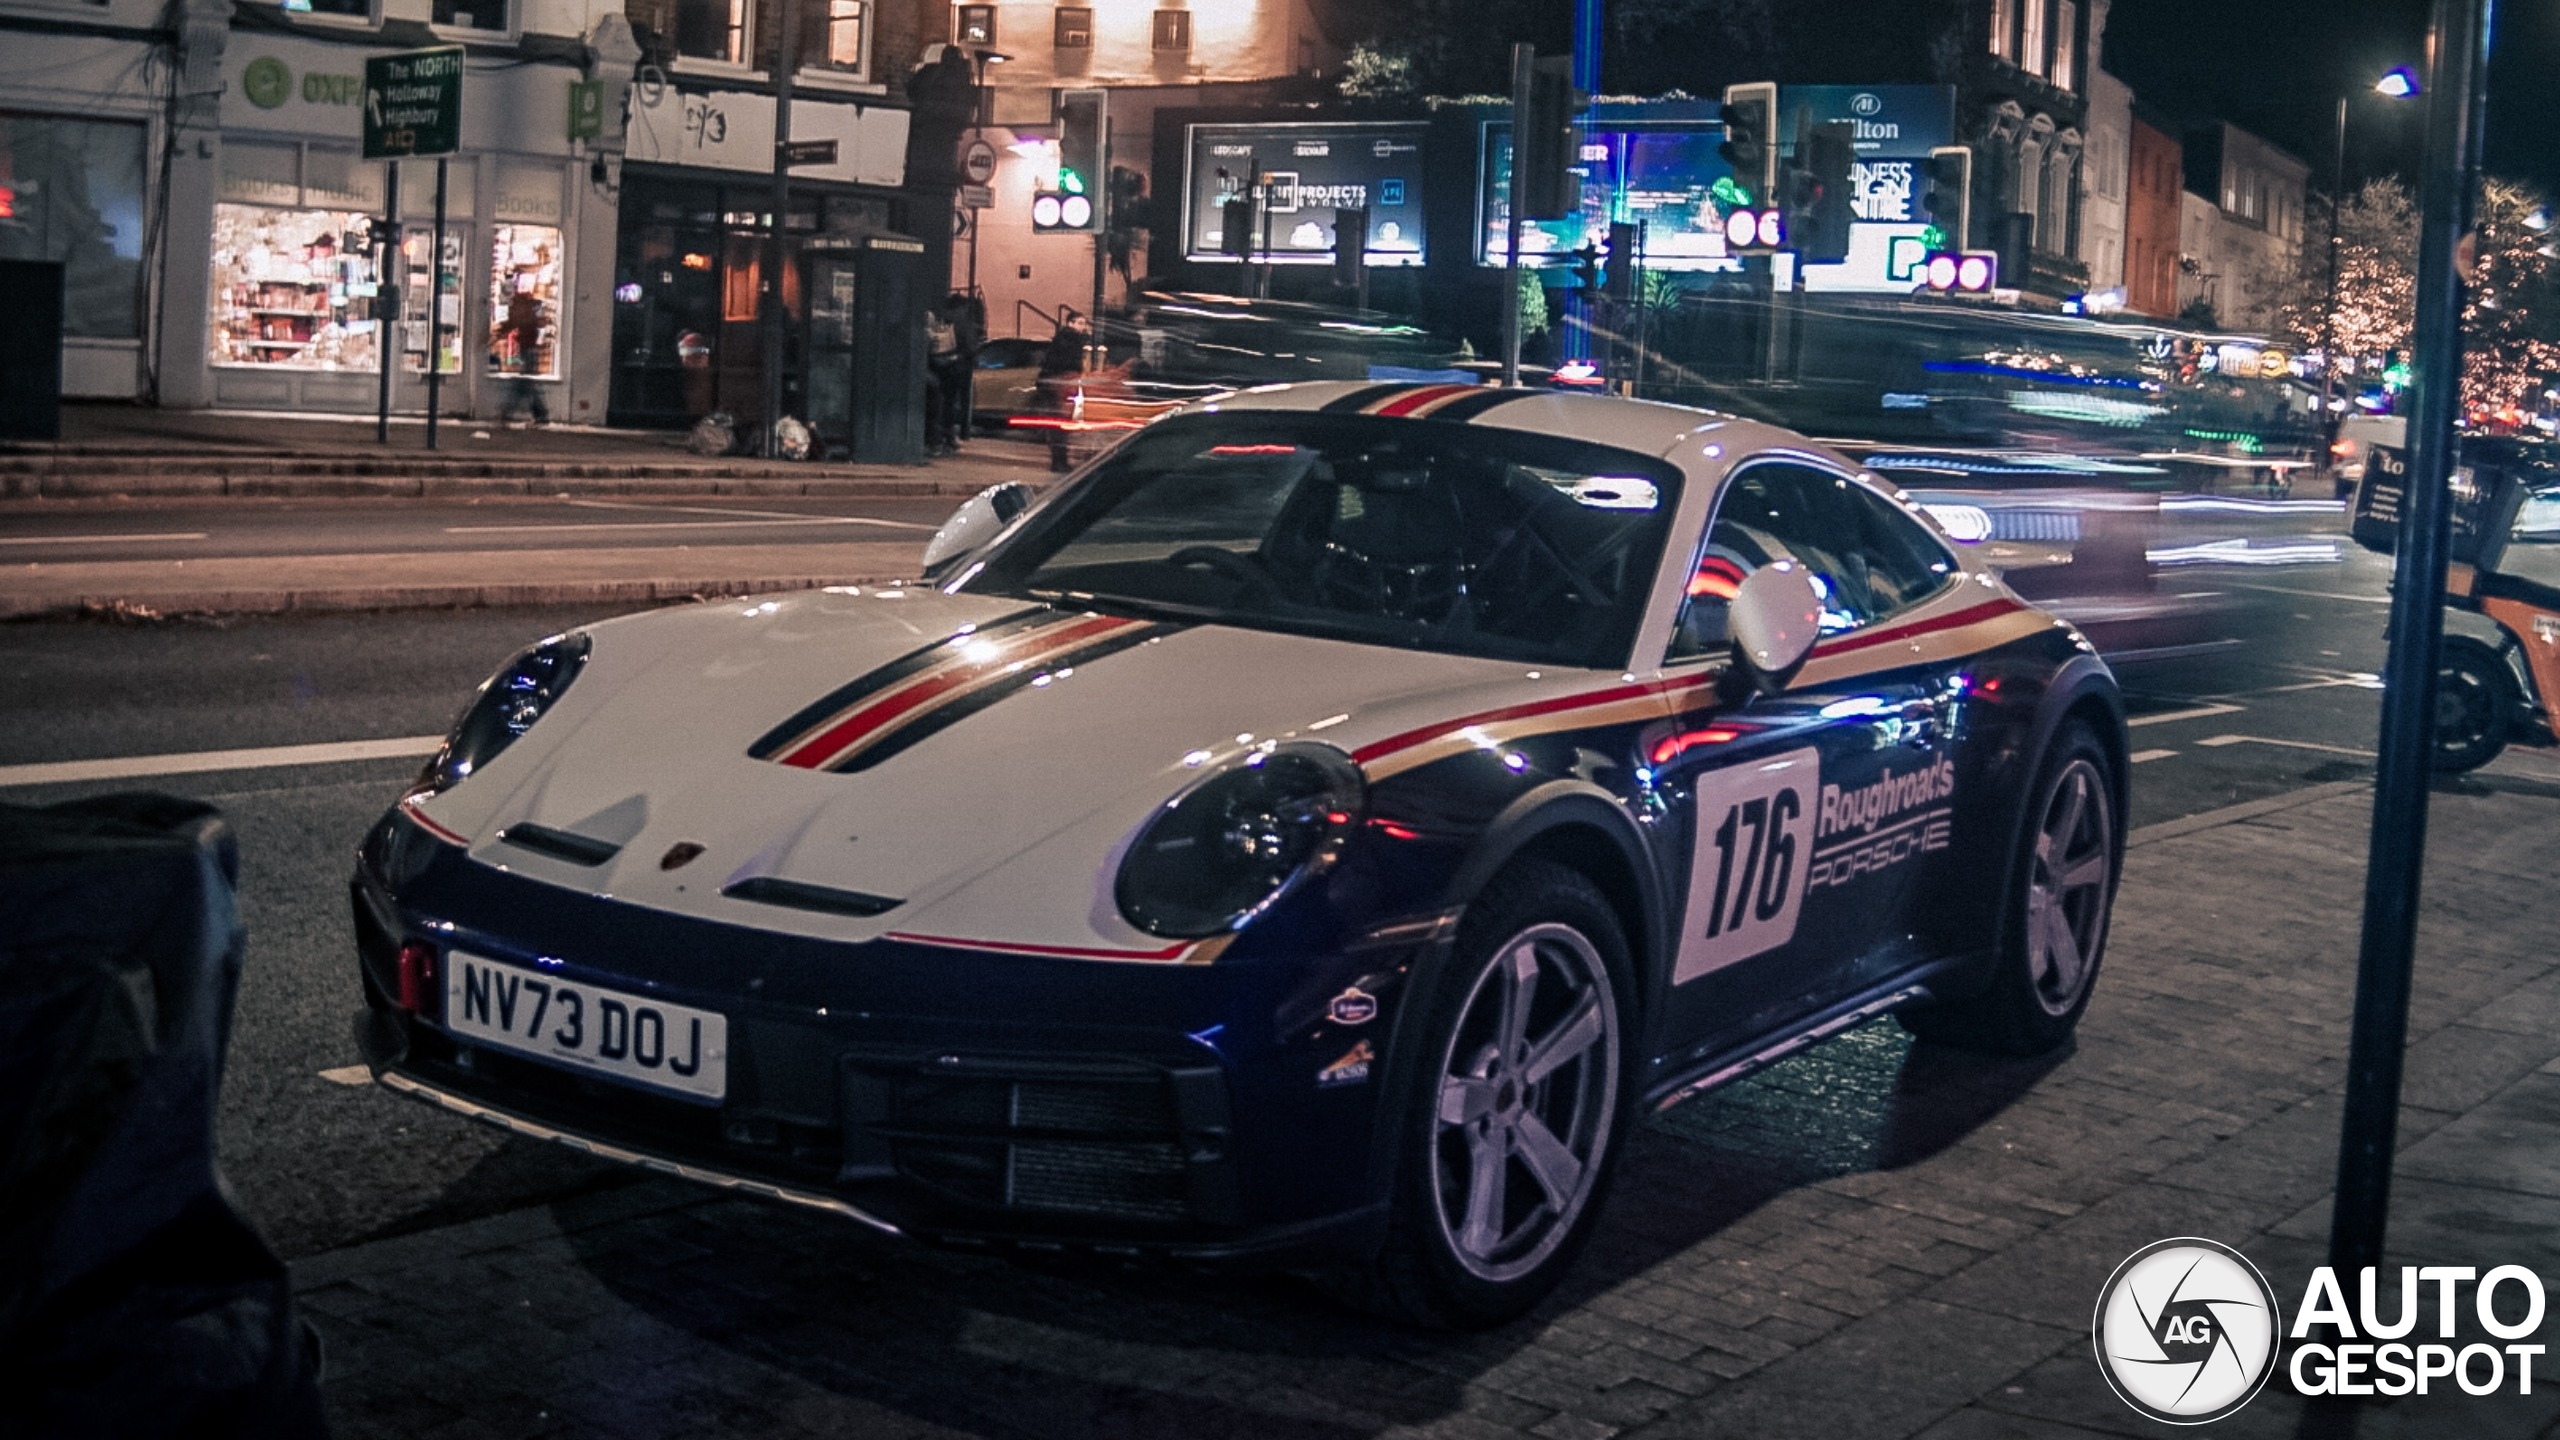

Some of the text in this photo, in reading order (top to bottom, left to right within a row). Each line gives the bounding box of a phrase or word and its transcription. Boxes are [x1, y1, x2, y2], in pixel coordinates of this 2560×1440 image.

[389, 56, 461, 79] The NORTH
[386, 84, 442, 103] Holloway
[386, 107, 439, 128] Highbury
[1298, 185, 1367, 200] PROJECTS
[1818, 751, 1954, 838] Roughroads
[1705, 787, 1800, 940] 176
[1807, 820, 1952, 895] PORSCHE
[464, 962, 701, 1078] NV73 DOJ
